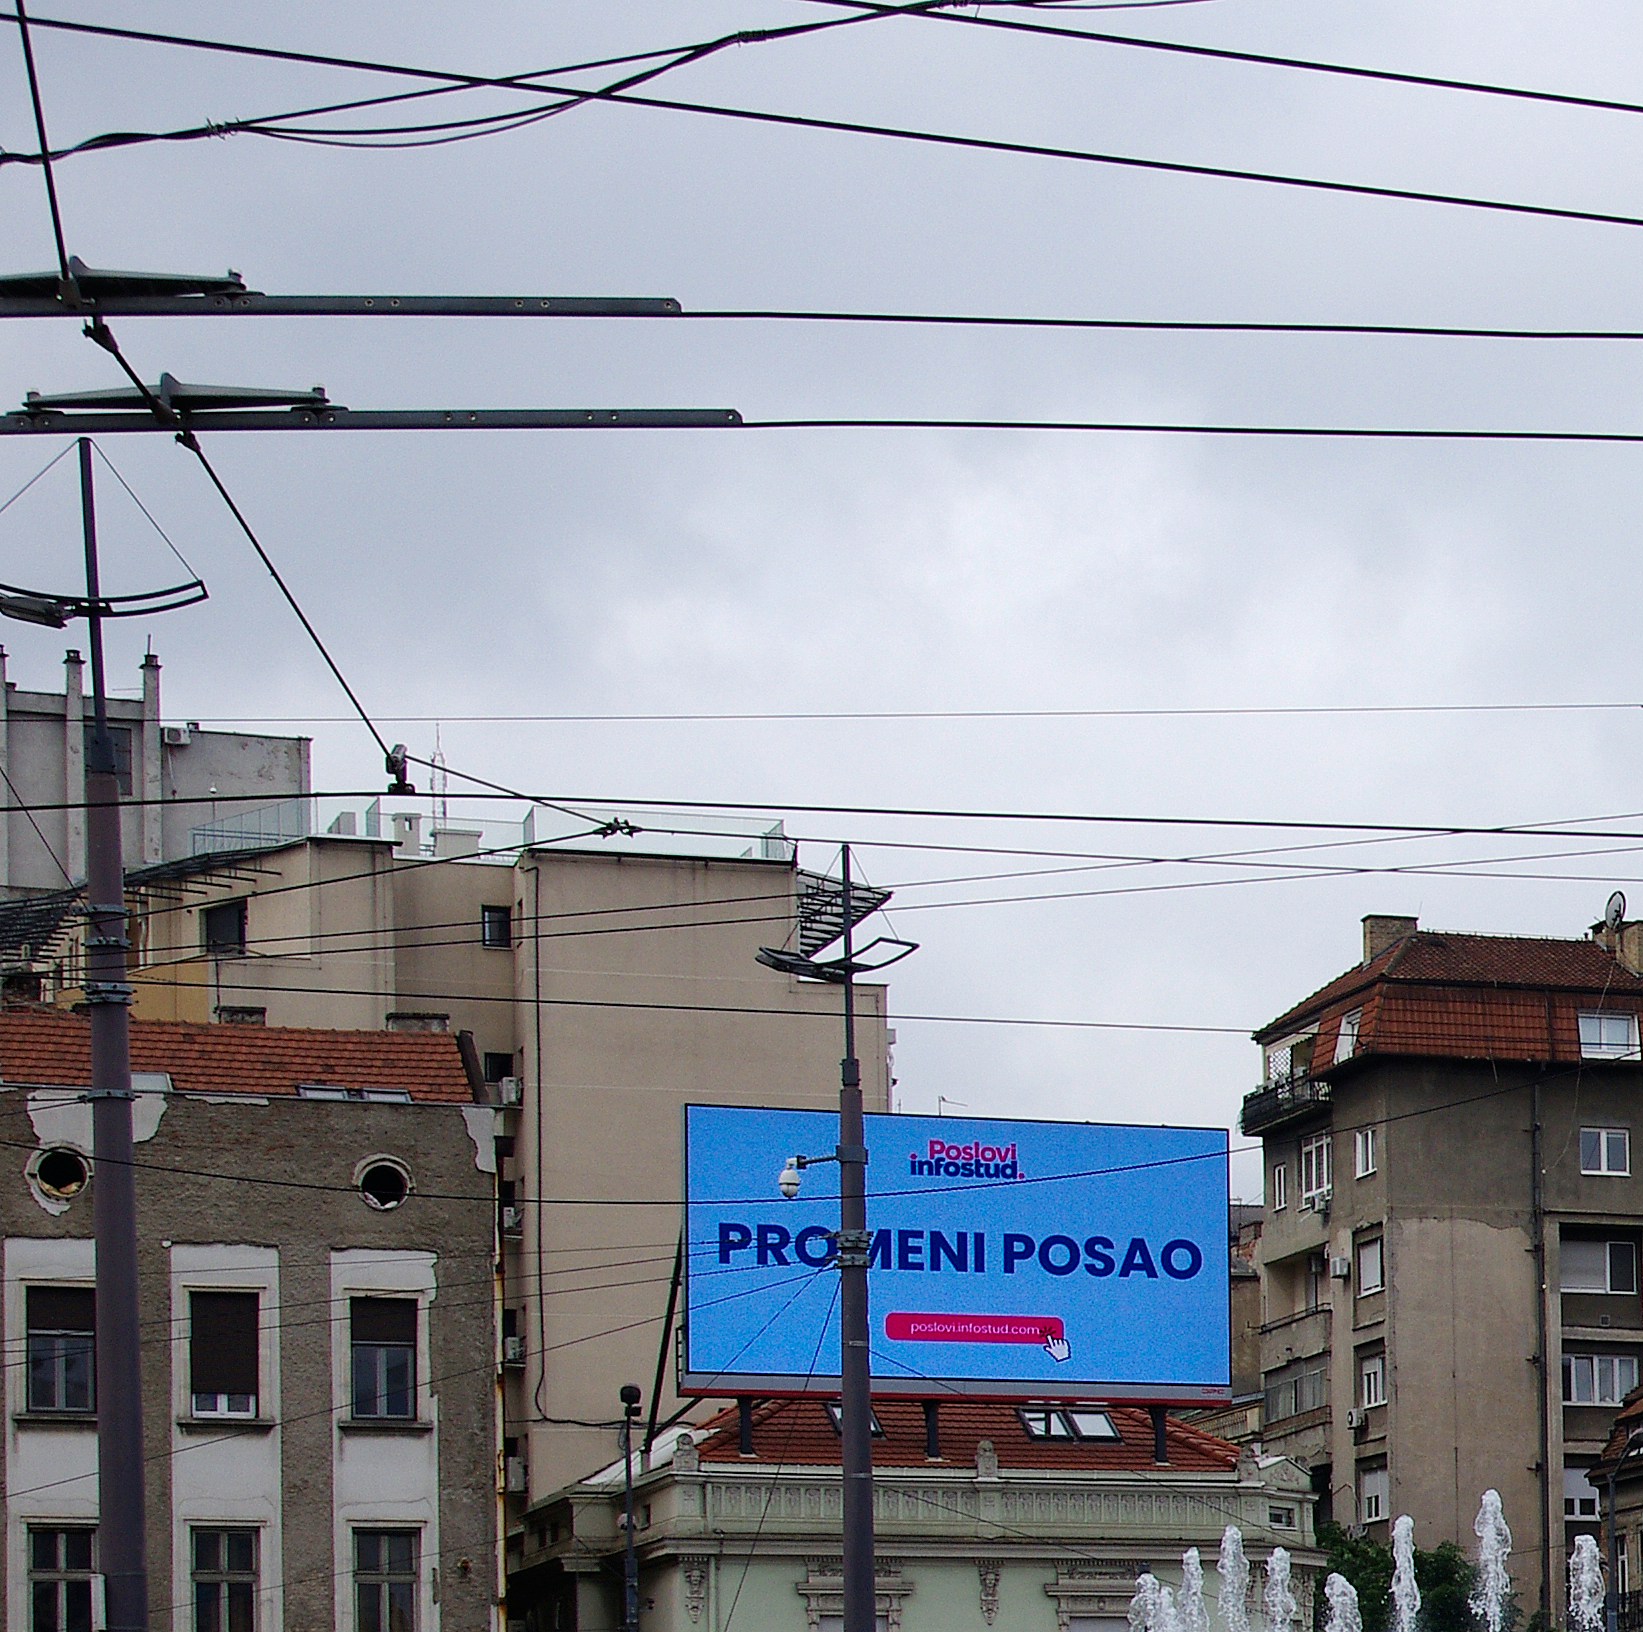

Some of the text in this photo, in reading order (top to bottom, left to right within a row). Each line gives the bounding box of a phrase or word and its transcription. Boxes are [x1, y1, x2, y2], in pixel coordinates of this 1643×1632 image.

[929, 1139, 1017, 1162] Poslovi
[1003, 1233, 1204, 1281] POSAO
[909, 1320, 1040, 1337] poslovi.infostud.com
